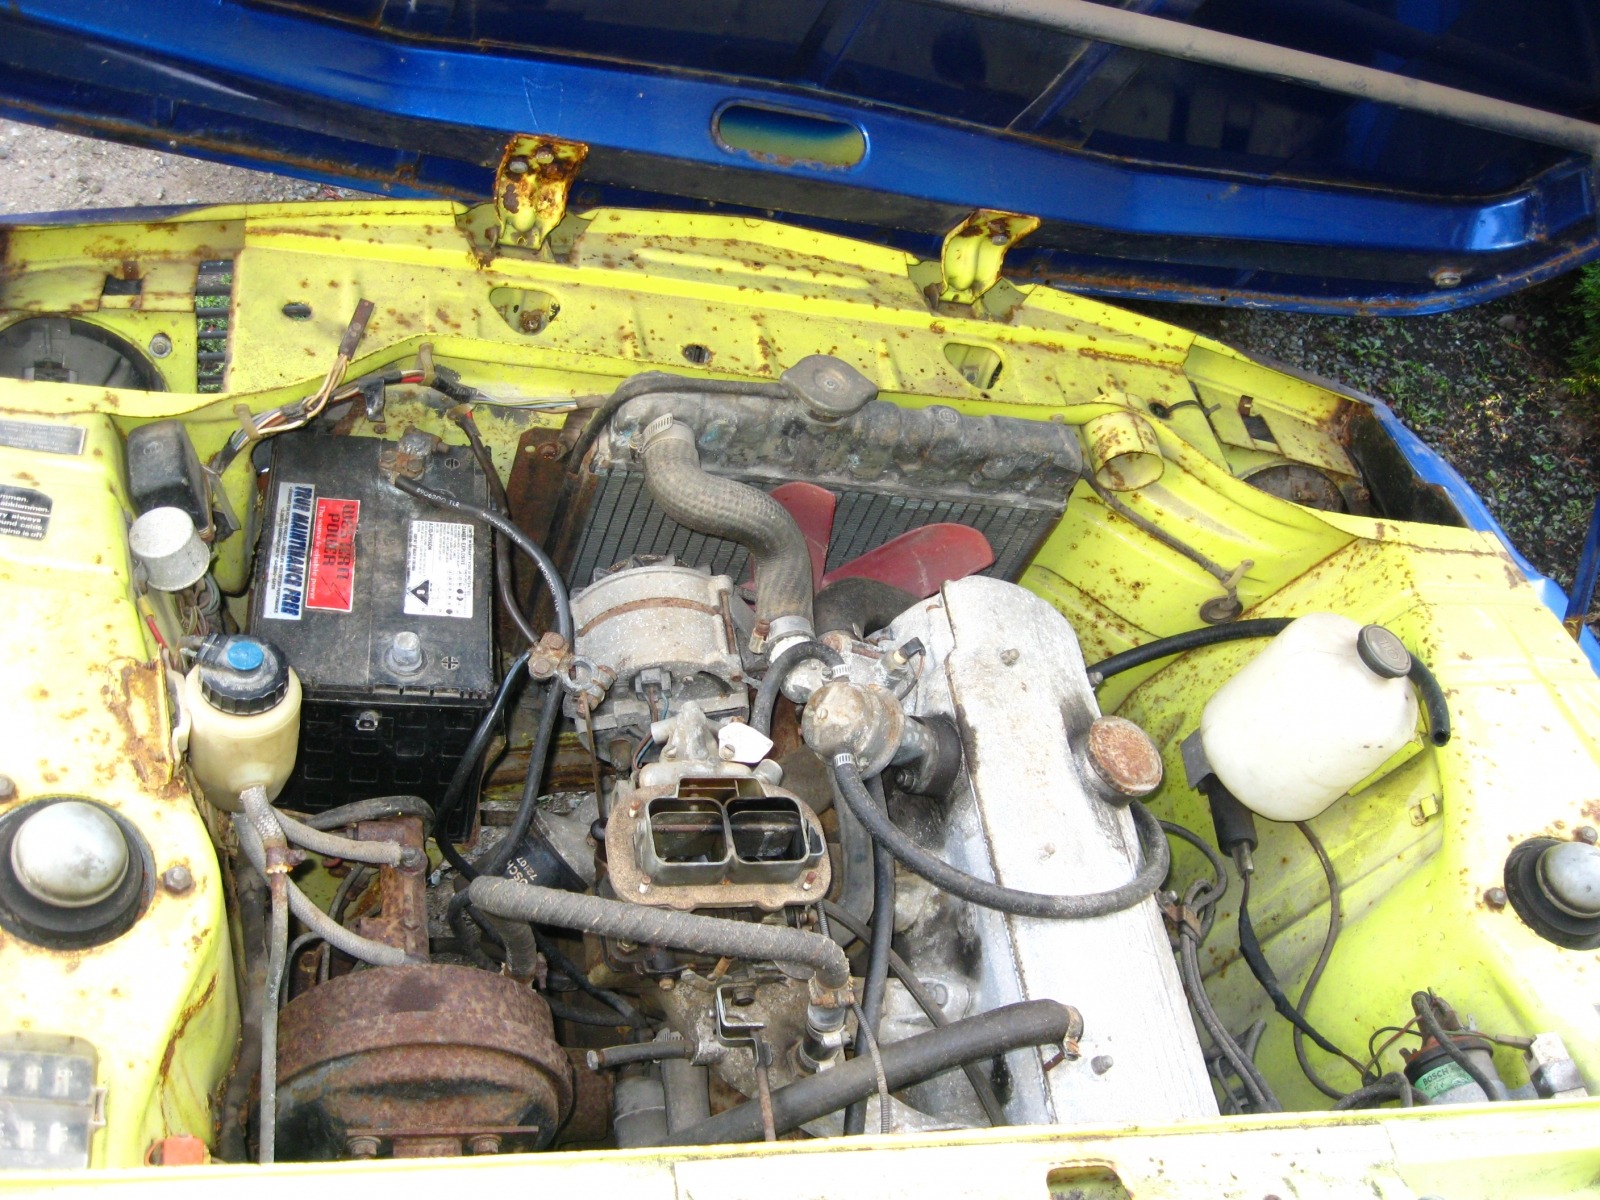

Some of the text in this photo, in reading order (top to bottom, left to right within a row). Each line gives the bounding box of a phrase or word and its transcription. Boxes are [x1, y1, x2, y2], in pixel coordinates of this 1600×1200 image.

[281, 486, 312, 616] TRUE MAINTENANCE FREE
[323, 513, 340, 566] POWER
[312, 549, 321, 576] reliable
[309, 578, 317, 601] power
[1423, 1067, 1450, 1086] BOSCH
